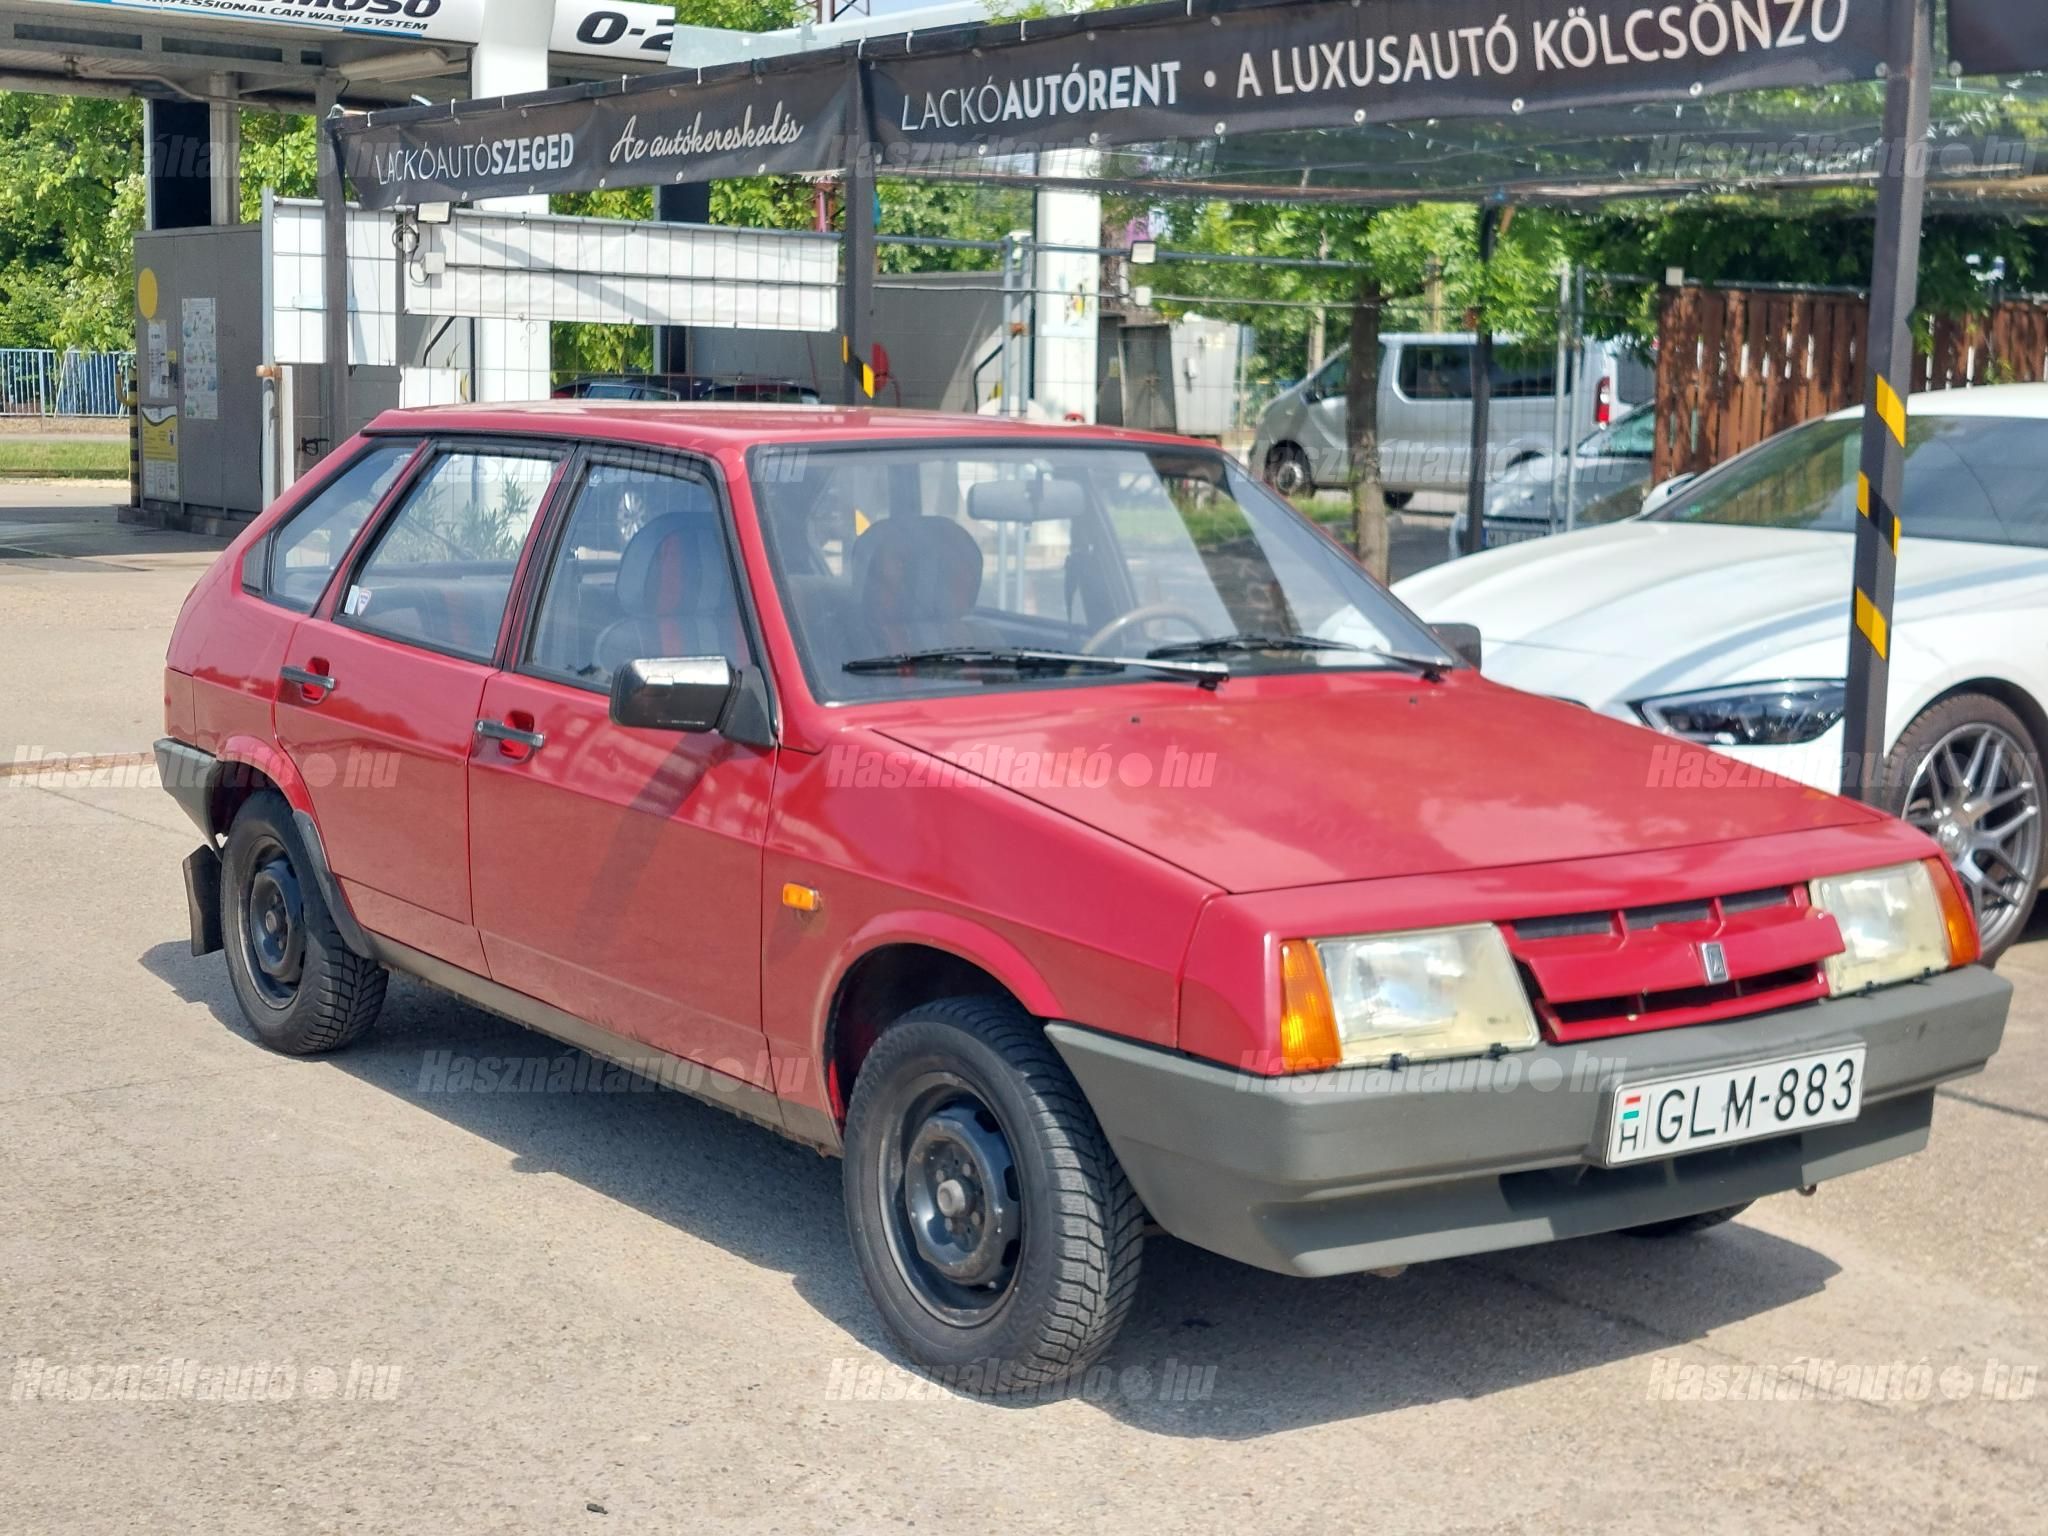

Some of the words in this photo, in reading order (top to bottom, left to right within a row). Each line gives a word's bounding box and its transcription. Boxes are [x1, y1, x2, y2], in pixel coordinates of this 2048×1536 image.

[147, 0, 266, 14] ESSIONAL
[270, 7, 304, 17] CAR
[308, 11, 360, 23] WASH
[362, 17, 429, 30] SYSTEM
[901, 61, 1181, 131] LACKÓAUTÓRENT
[1236, 53, 1262, 98] A
[1272, 14, 1519, 95] LUXUSAUTÓ
[375, 132, 574, 185] LACKÓAUTÓSZEGED
[610, 115, 648, 163] Az
[649, 100, 804, 158] autókereskedés
[1656, 1058, 1854, 1144] GLM-883
[1618, 1122, 1639, 1154] H
